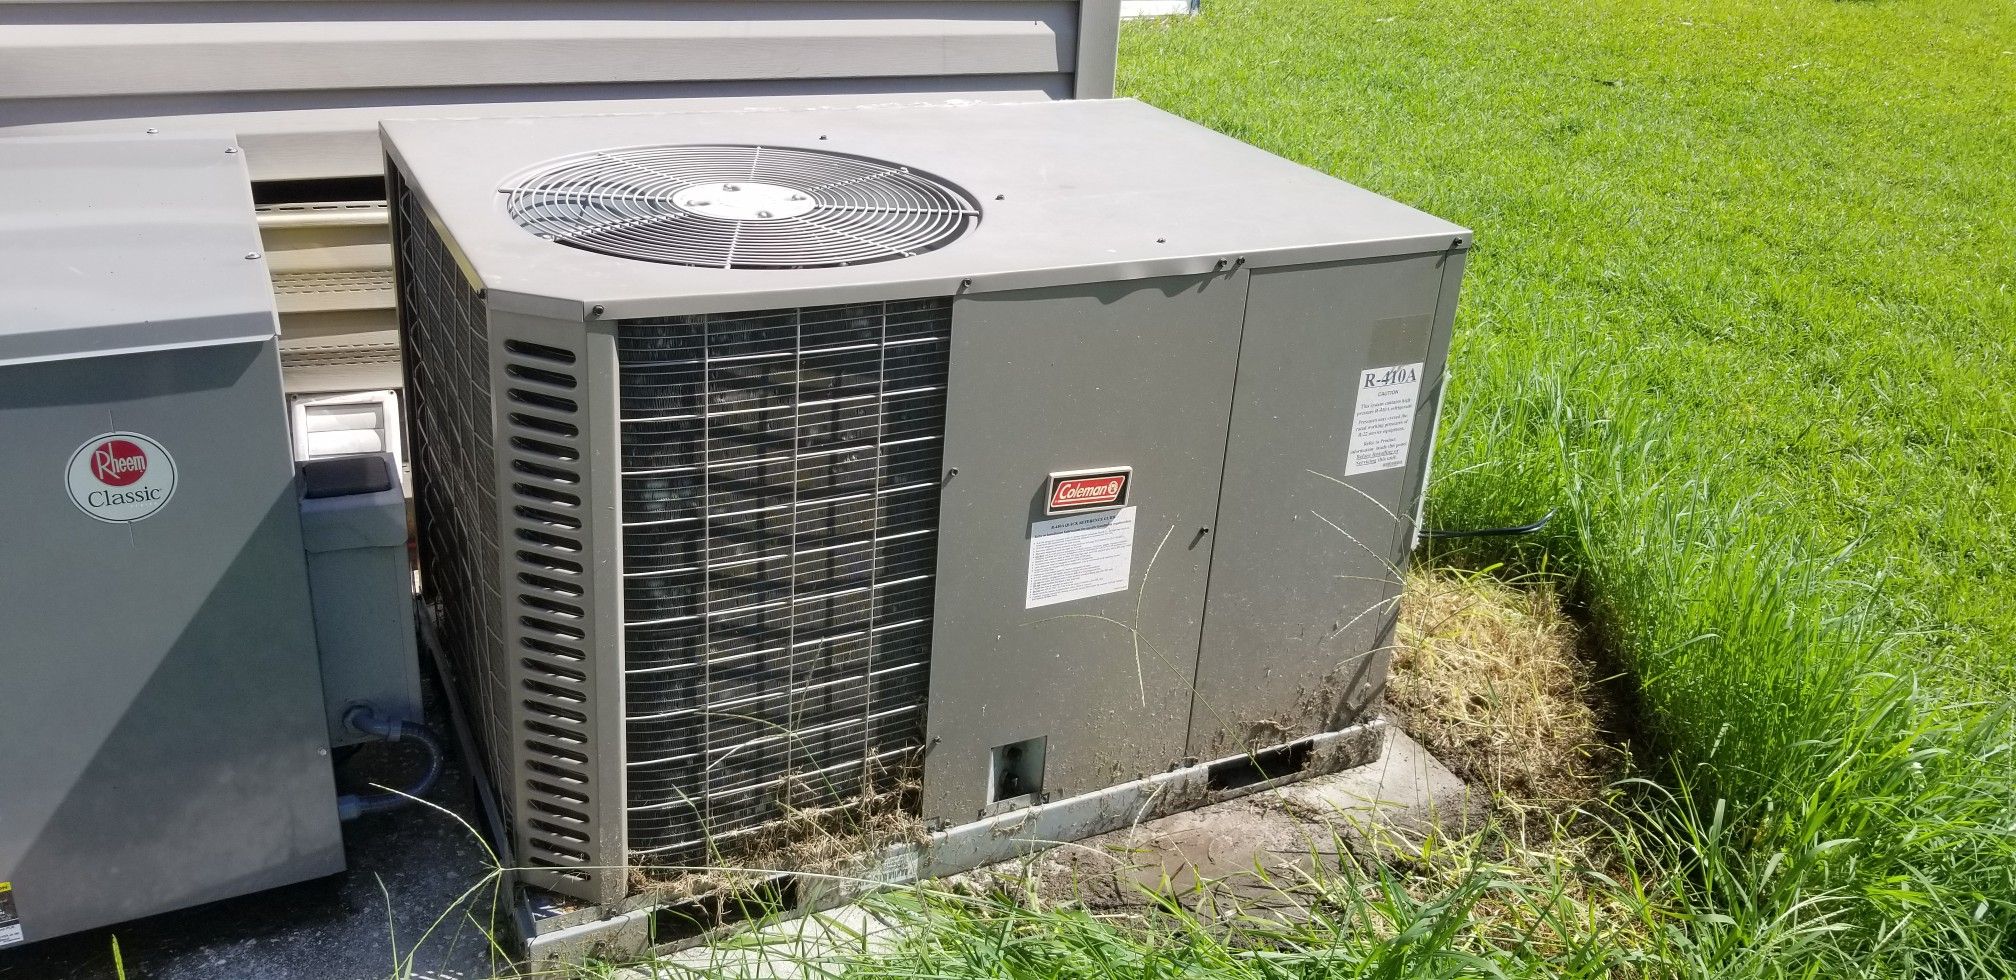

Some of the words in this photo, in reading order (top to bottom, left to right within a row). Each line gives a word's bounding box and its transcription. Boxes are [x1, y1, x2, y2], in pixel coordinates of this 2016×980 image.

[1364, 368, 1416, 388] R-410A
[95, 442, 145, 480] Rheem
[88, 486, 160, 508] Classic
[1059, 482, 1106, 499] Coleman
